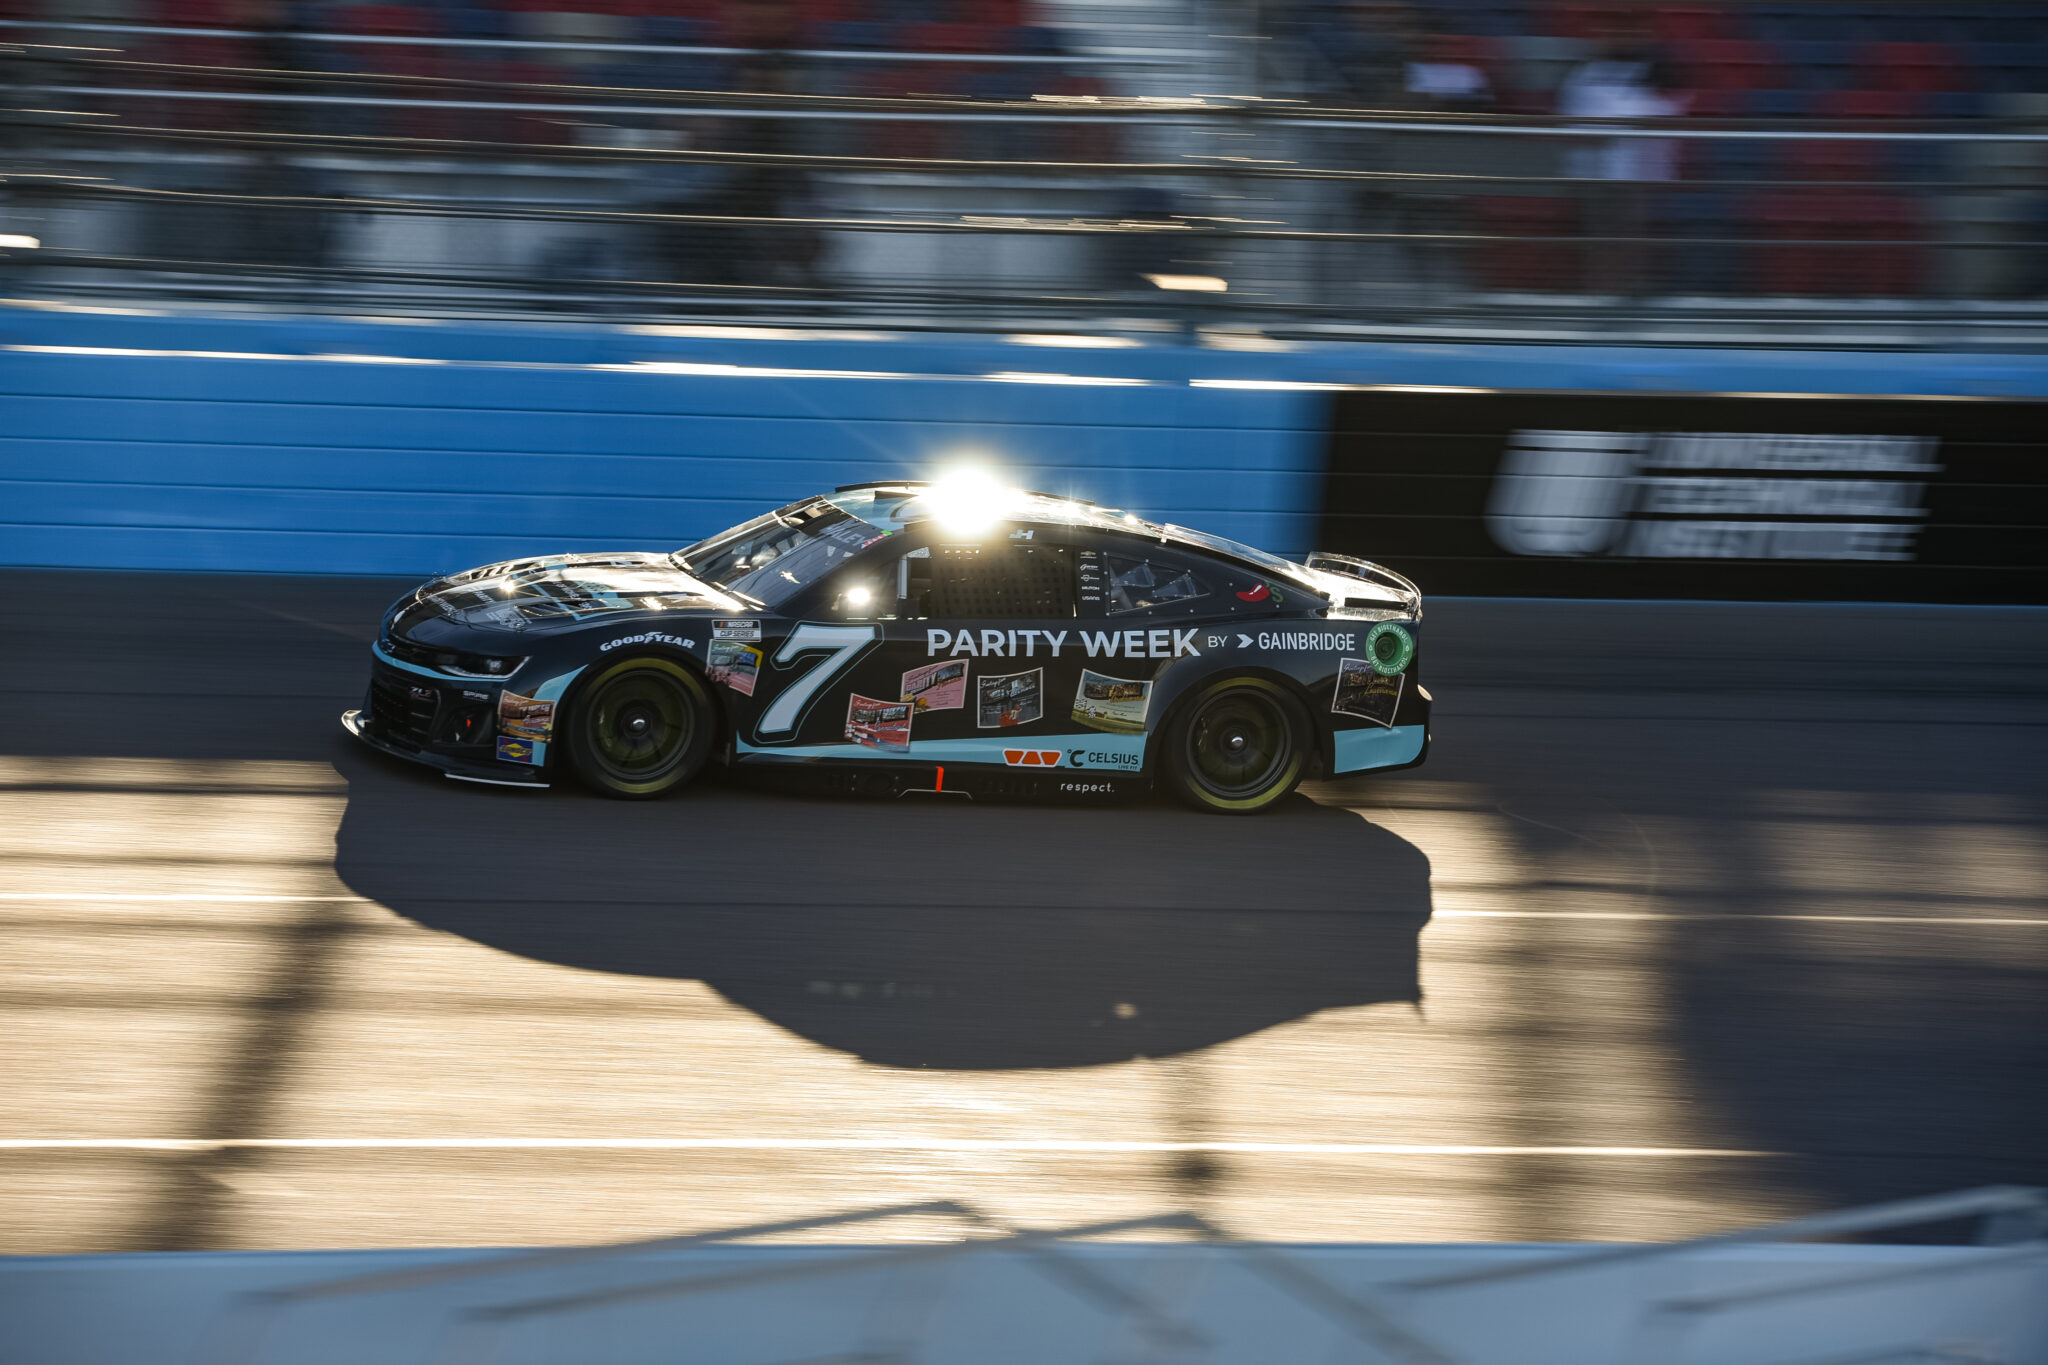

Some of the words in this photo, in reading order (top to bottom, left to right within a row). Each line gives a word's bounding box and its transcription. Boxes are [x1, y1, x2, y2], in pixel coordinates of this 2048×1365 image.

[600, 631, 696, 651] GOODYEAR
[735, 630, 755, 638] SERIES
[927, 629, 1068, 657] PARITY
[1079, 628, 1201, 658] WEEK
[1207, 635, 1228, 648] BY
[1258, 632, 1355, 651] GAINBRIDGE
[757, 623, 877, 735] 7
[1088, 751, 1139, 765] CELSIUS
[1060, 782, 1115, 794] respect.
